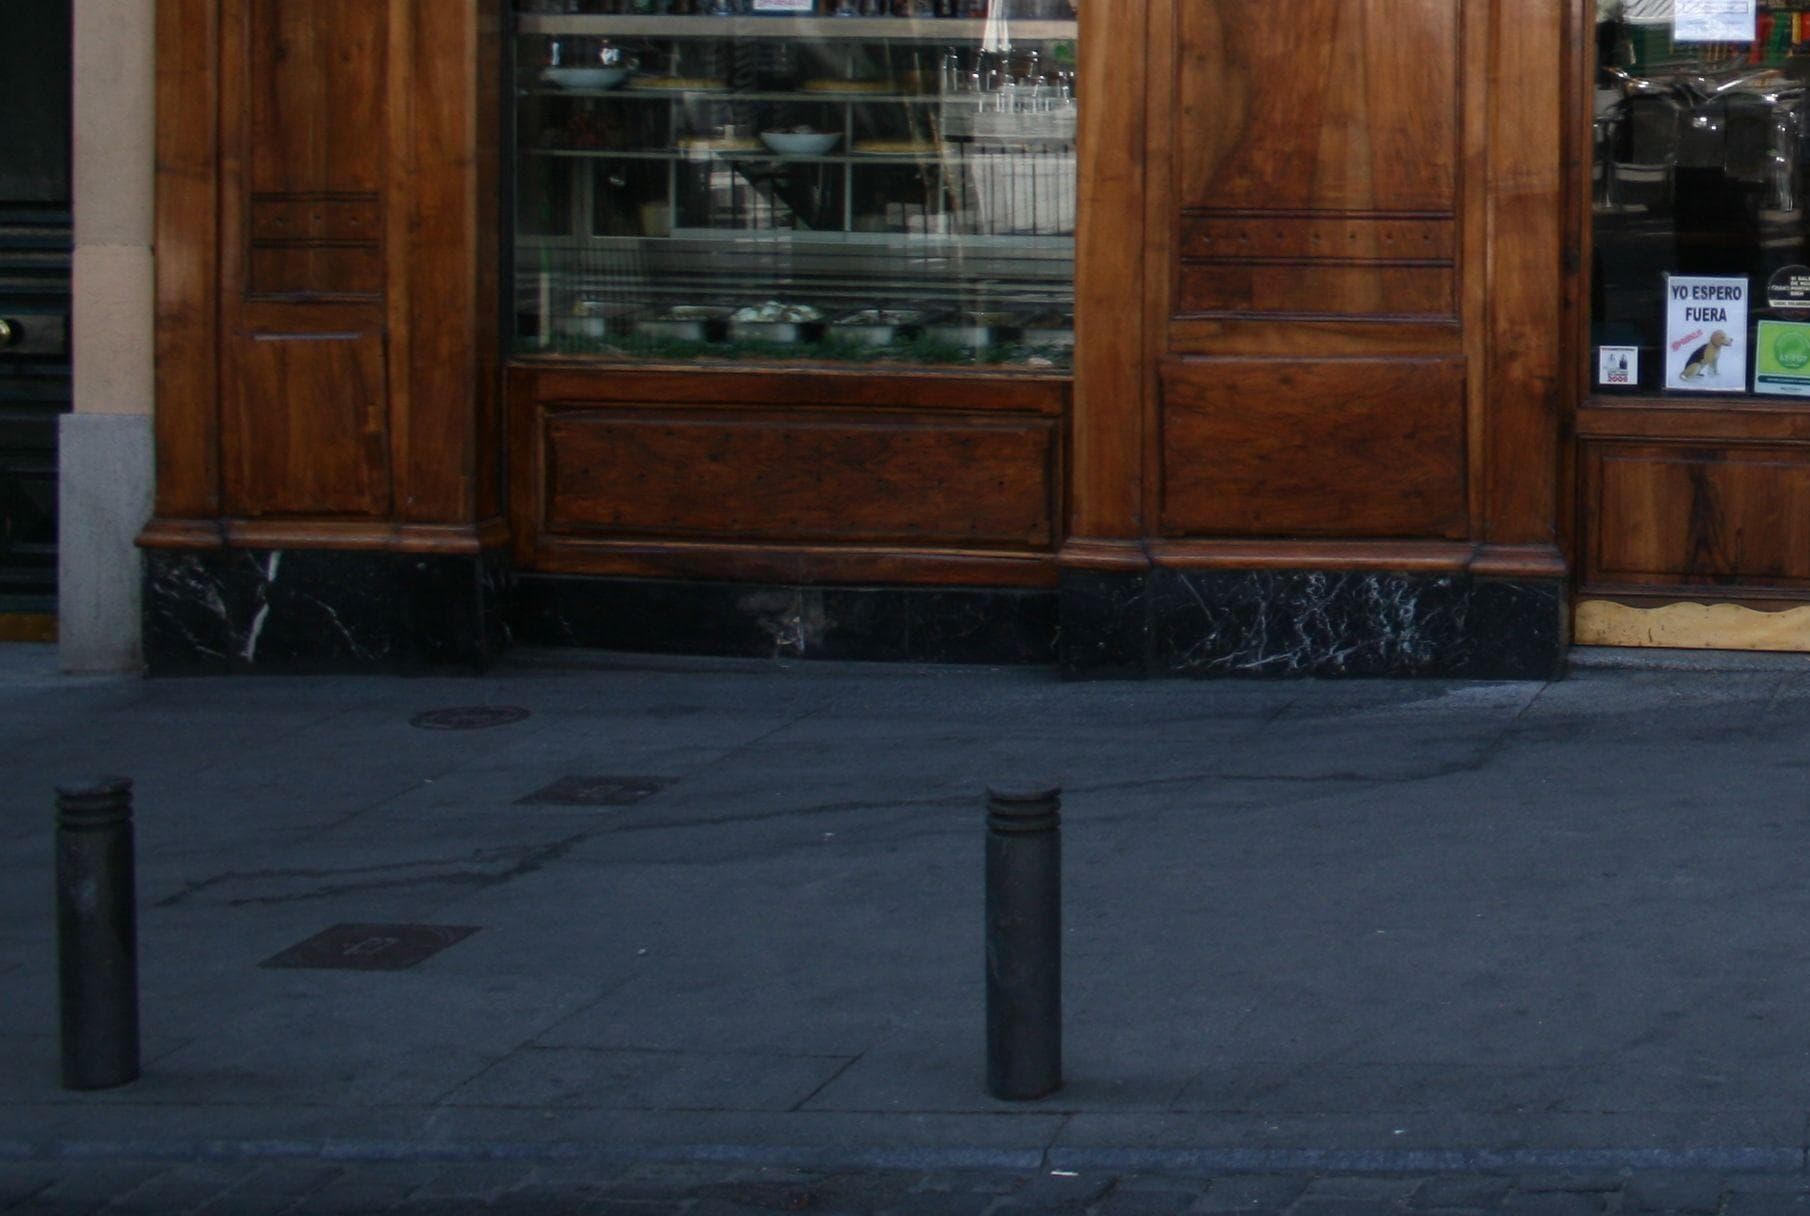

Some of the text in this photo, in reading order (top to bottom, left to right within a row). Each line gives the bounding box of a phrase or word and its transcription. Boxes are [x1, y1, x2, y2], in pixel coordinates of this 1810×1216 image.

[1671, 285, 1742, 301] YO ESPERO
[1685, 307, 1728, 323] FUERA
